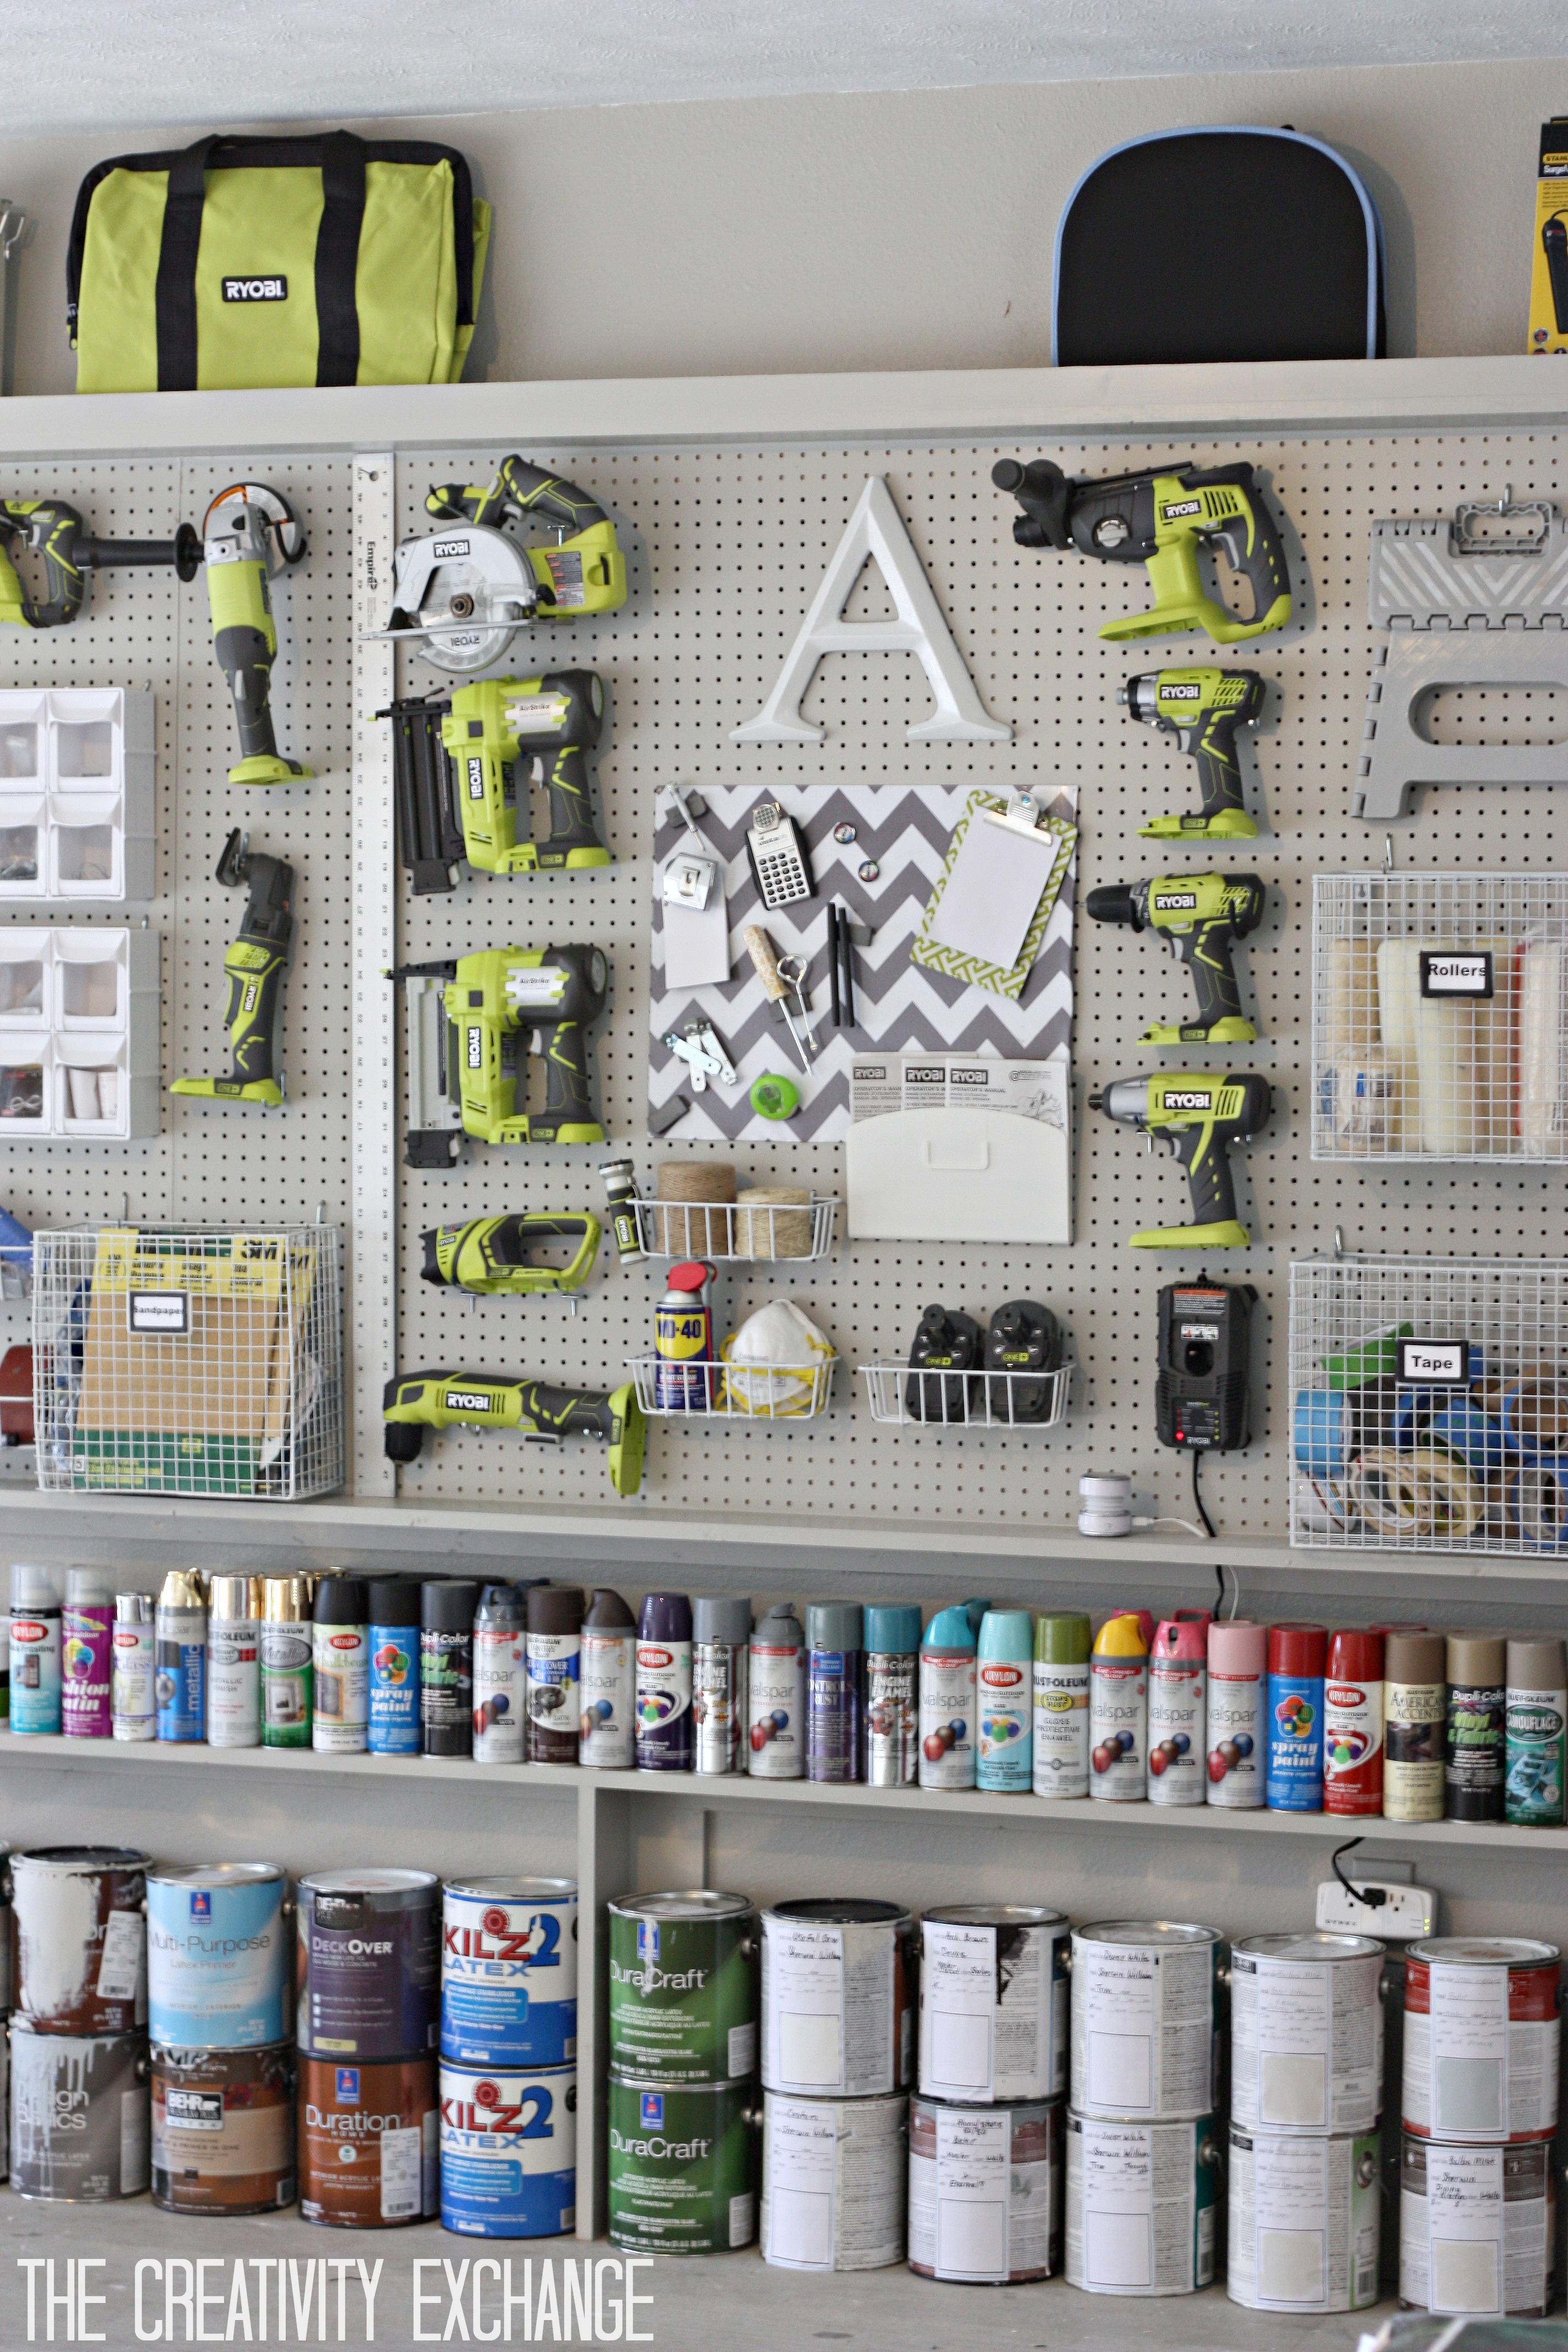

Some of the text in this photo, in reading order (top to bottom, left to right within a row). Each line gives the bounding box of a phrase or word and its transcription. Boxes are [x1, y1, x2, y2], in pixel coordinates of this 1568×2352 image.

[226, 280, 282, 299] RYOBI
[1167, 502, 1200, 519] RYOBI
[434, 541, 470, 557] RYOBI
[367, 541, 377, 590] Empire
[728, 474, 1016, 746] A
[1161, 684, 1200, 699] RYOBI
[469, 759, 483, 798] RYOBI
[1156, 894, 1195, 909] RYOBI
[1428, 962, 1487, 978] Rollers
[244, 986, 258, 1011] RYOBI
[469, 1028, 481, 1068] RYOBI
[854, 1069, 885, 1079] RYOBI
[907, 1070, 944, 1082] RYOBI
[951, 1071, 988, 1083] RYOBI
[1166, 1093, 1211, 1109] RYOBI
[618, 1218, 630, 1243] RYOBI
[439, 1236, 456, 1246] RYOBI
[240, 1240, 277, 1260] 3M
[658, 1319, 701, 1338] WD-40
[1411, 1354, 1453, 1371] Tape
[447, 1392, 491, 1411] RYOBI
[1186, 1436, 1211, 1445] RYOBI
[188, 1644, 202, 1711] metallic
[984, 1670, 1017, 1683] KRYLON
[370, 1687, 414, 1702] spray
[750, 1682, 796, 1702] valspar
[814, 1693, 838, 1706] RUST
[1327, 1690, 1360, 1703] KRYLON
[371, 1697, 411, 1713] paint
[922, 1694, 971, 1711] valspar
[1091, 1705, 1140, 1723] valspar
[1149, 1706, 1197, 1724] valspar
[1208, 1707, 1257, 1724] valspar
[1272, 1740, 1319, 1757] spray
[1273, 1754, 1316, 1768] paint
[443, 1925, 531, 1961] KILZ
[610, 1959, 705, 1992] DuraCraft
[169, 2093, 204, 2108] BEHR
[306, 2104, 401, 2131] Duration
[440, 2085, 554, 2139] KILZ 2
[611, 2128, 709, 2160] DuraCraft
